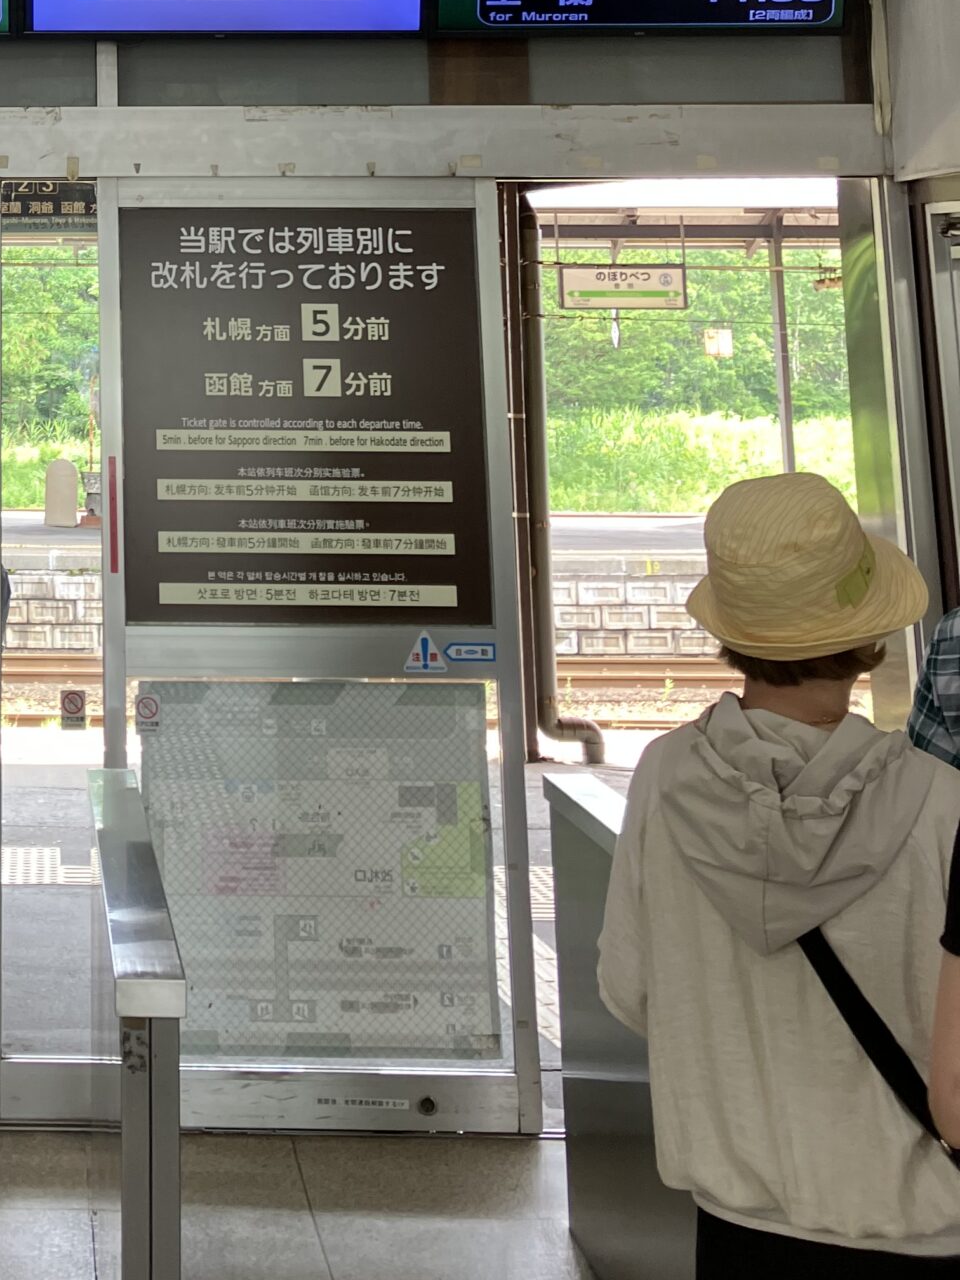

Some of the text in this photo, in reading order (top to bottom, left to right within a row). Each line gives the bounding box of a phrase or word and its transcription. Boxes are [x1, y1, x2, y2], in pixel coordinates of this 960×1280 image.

[490, 11, 587, 21] for Muroran
[179, 226, 414, 255] 当駅では列車別に
[151, 262, 445, 290] 改札を行っております
[596, 272, 651, 281] のぼりべつ
[311, 310, 330, 336] 5
[343, 317, 389, 341] 分前
[312, 365, 332, 392] 7
[344, 373, 392, 396] 分前
[182, 418, 424, 431] Ticket gate is controlled according to each departure time.
[188, 435, 213, 444] before
[215, 435, 226, 444] for
[229, 435, 260, 447] Sapporo
[263, 436, 296, 445] direction
[330, 437, 354, 446] before
[357, 437, 368, 446] for
[370, 437, 407, 446] Hakodate
[410, 437, 444, 447] direction
